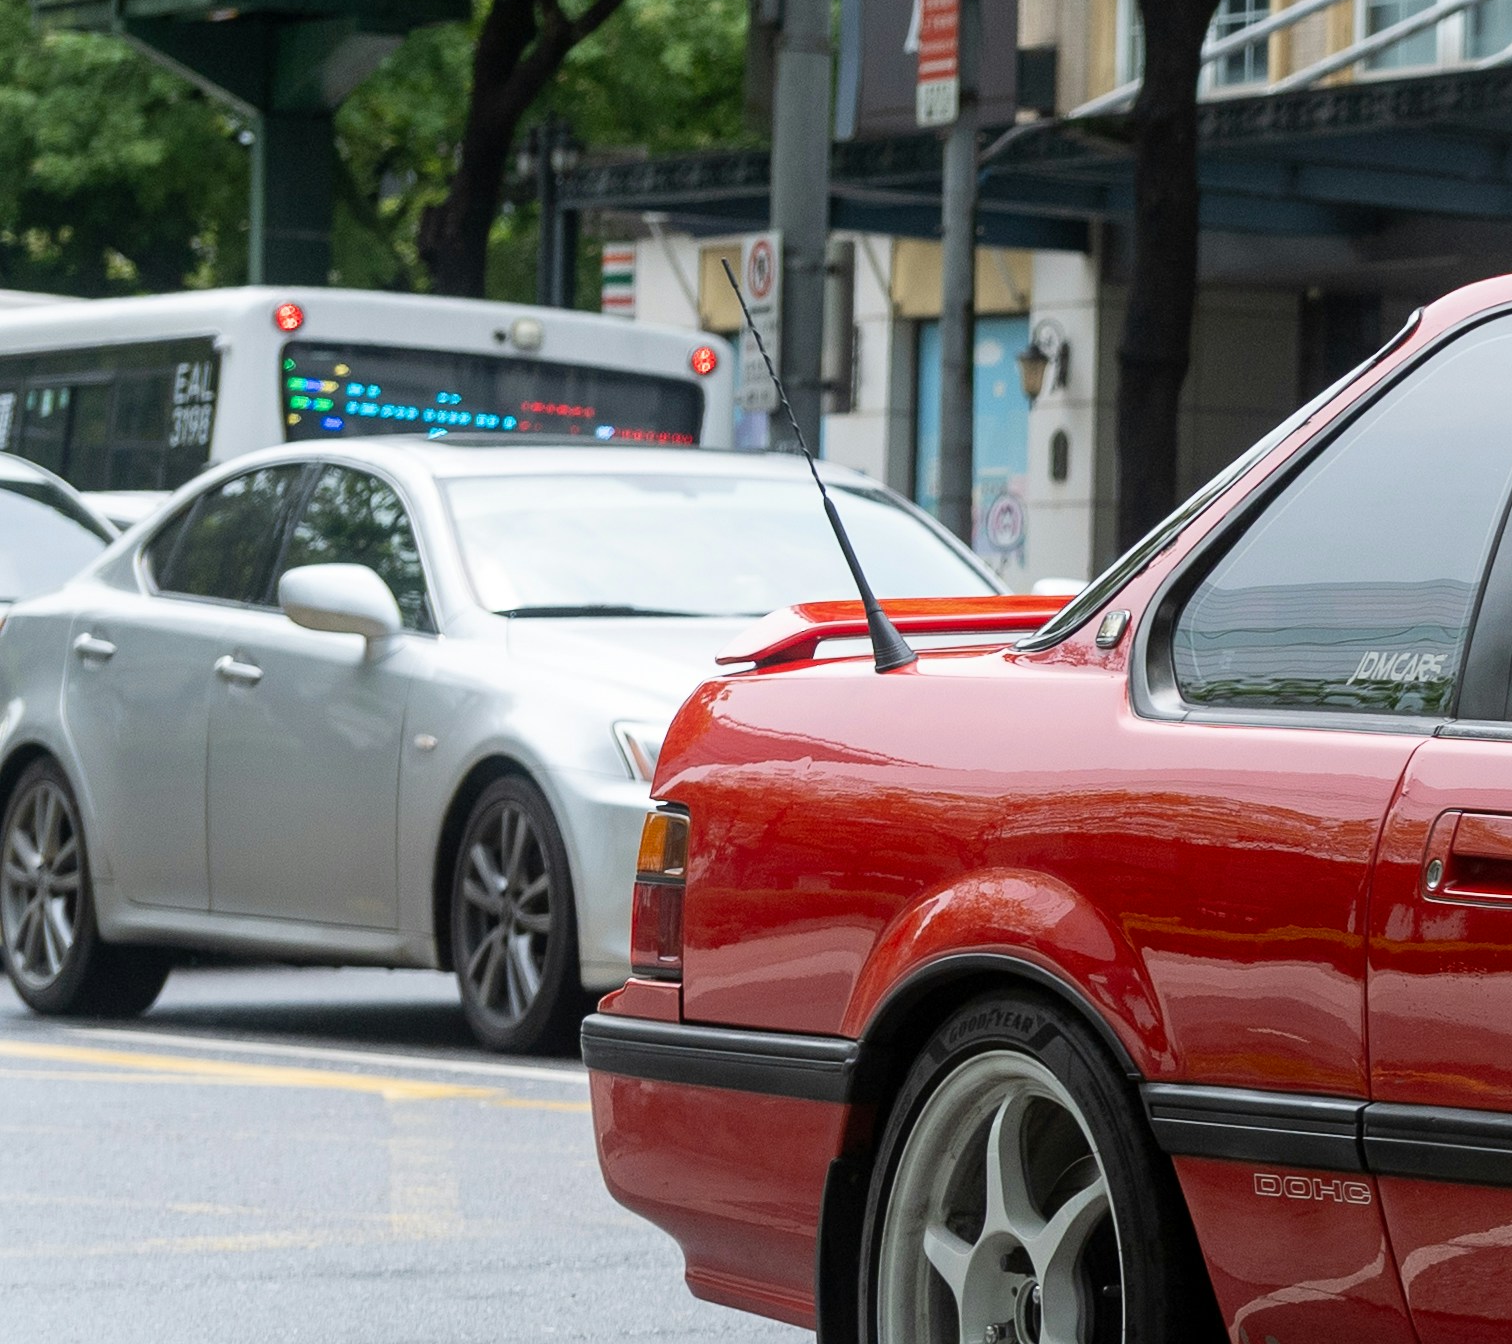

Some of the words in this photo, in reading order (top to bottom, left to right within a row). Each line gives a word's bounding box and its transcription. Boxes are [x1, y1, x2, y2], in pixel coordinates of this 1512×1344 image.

[174, 360, 215, 405] EAL
[948, 1008, 1033, 1044] GOODYEAR
[1253, 1173, 1371, 1205] DOHC
